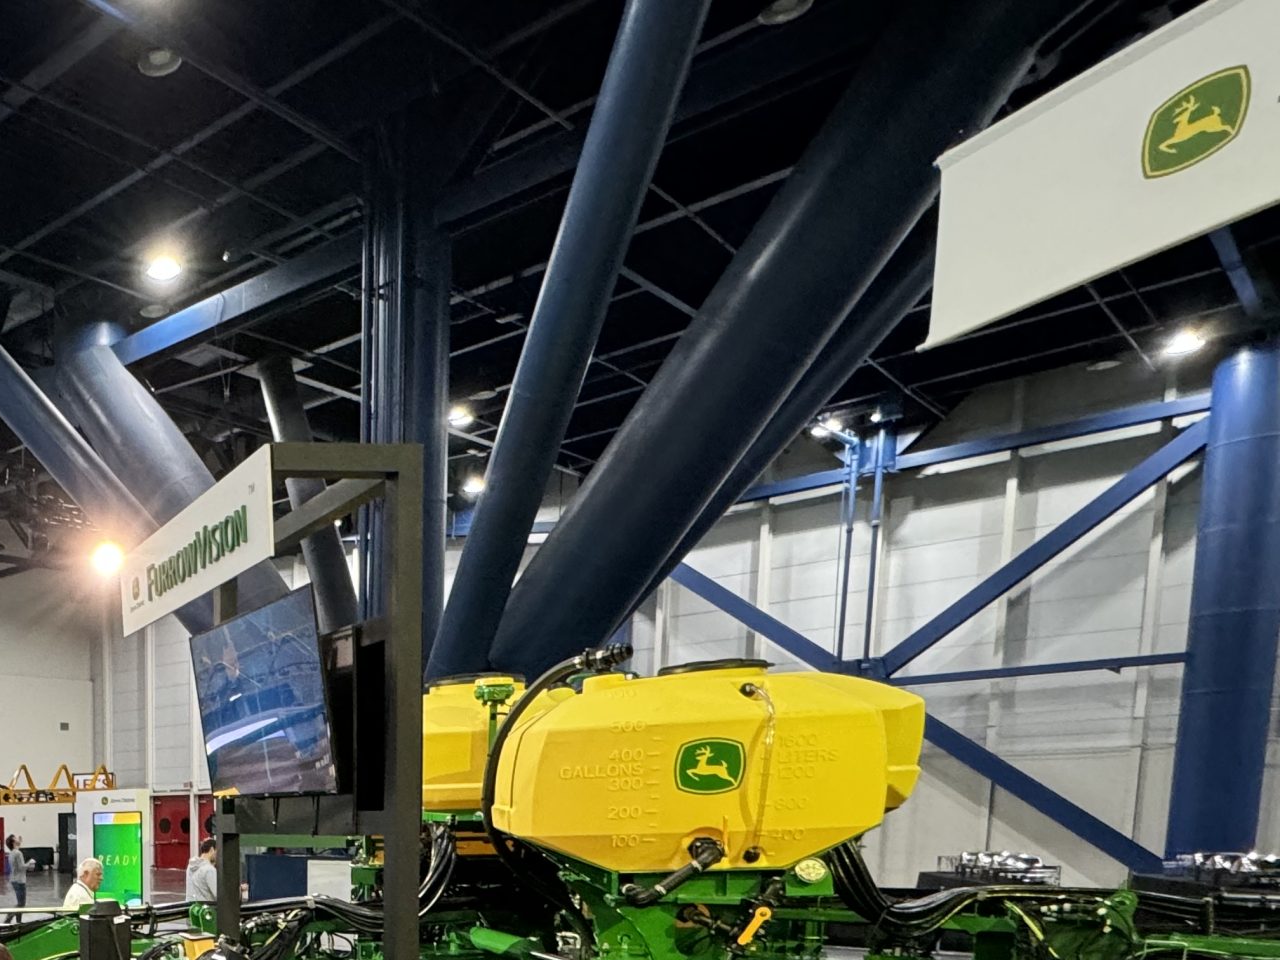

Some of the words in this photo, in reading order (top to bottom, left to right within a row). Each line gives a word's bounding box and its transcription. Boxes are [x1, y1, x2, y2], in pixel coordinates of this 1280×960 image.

[147, 505, 248, 602] FURROWVISION
[610, 720, 647, 732] 500
[608, 749, 644, 762] 400
[778, 748, 839, 764] LITERS
[559, 763, 644, 780] GALLONS
[778, 766, 815, 780] 1200
[607, 778, 643, 791] 300
[607, 806, 642, 820] 200
[611, 834, 640, 849] 100
[99, 855, 138, 866] READY
